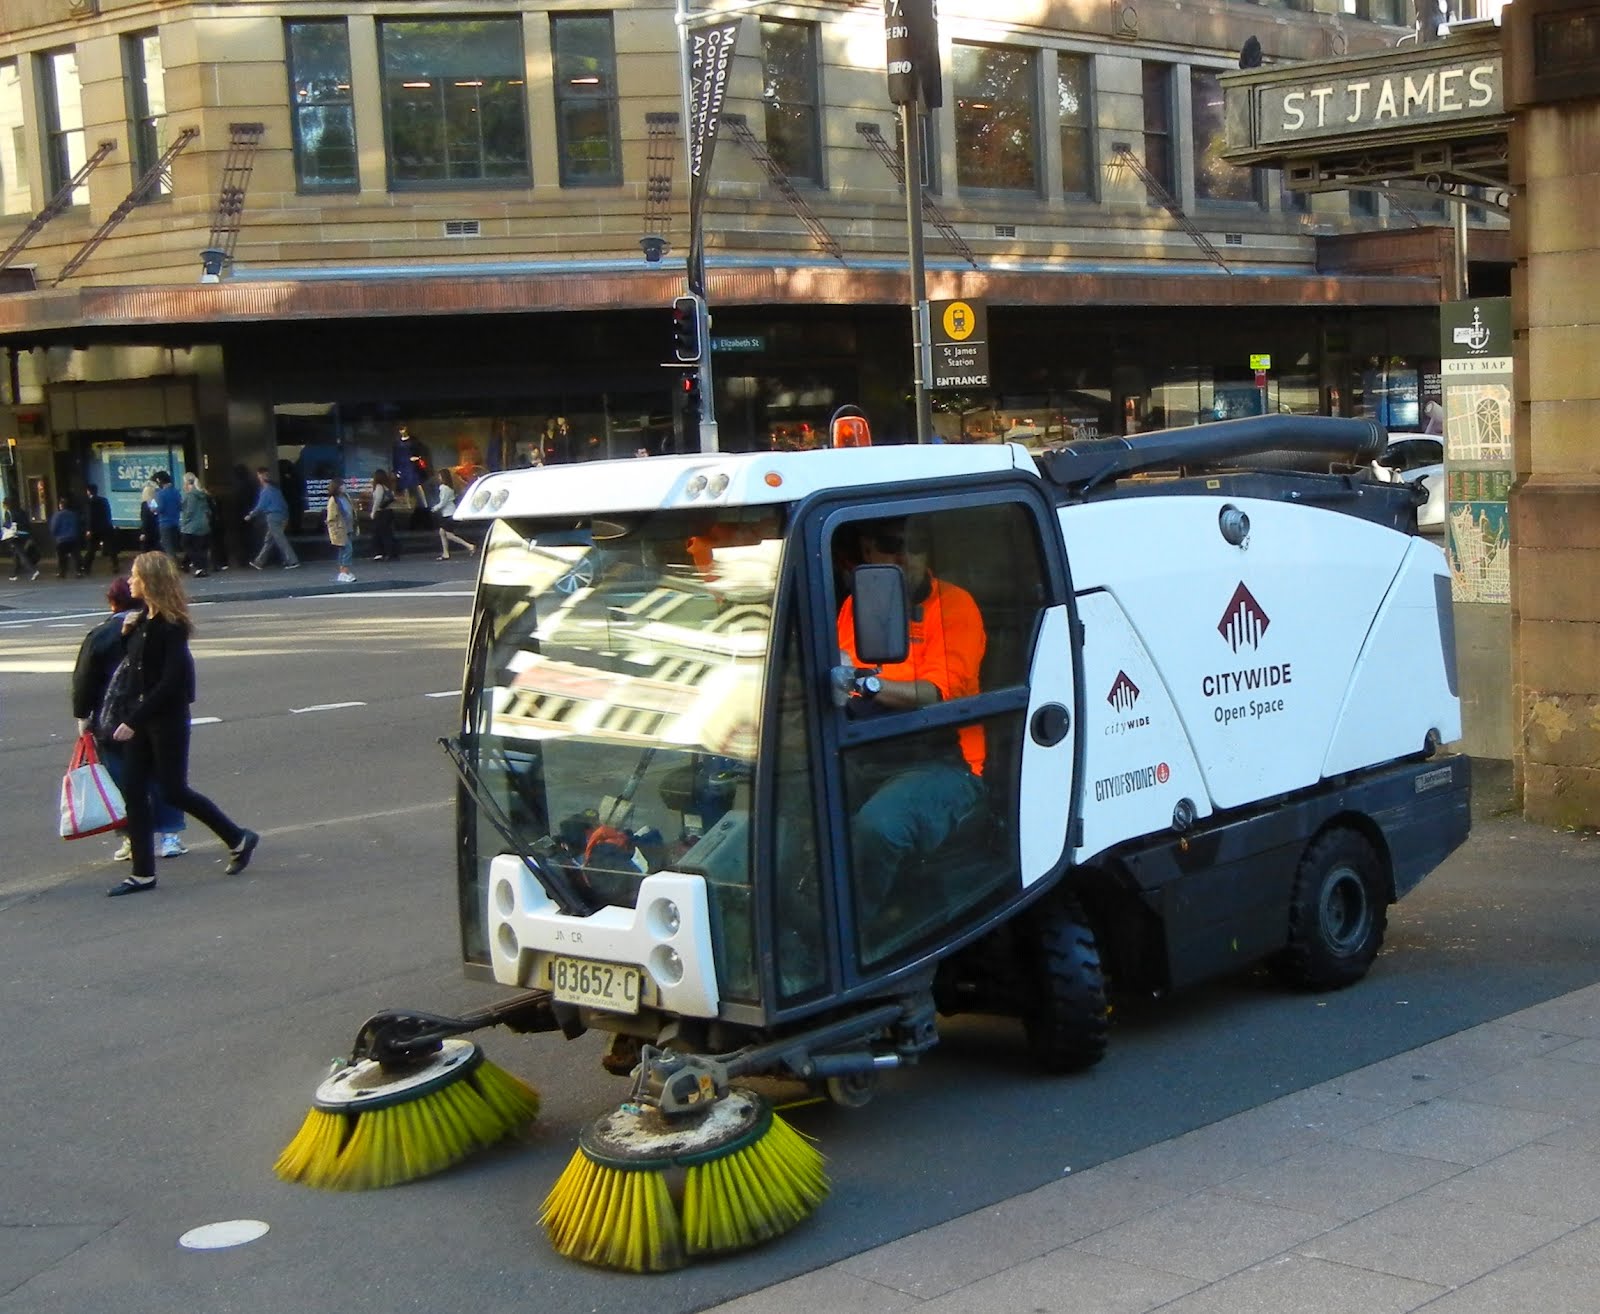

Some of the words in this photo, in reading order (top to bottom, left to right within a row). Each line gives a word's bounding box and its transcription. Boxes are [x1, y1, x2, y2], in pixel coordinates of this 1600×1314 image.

[692, 35, 706, 69] Art
[692, 30, 721, 177] Contemporary
[1283, 87, 1333, 131] ST
[1347, 66, 1494, 123] JAMES
[720, 338, 750, 348] Elizabeth
[751, 338, 760, 347] St
[943, 347, 951, 356] St
[954, 346, 977, 358] James
[947, 357, 975, 367] Station
[1448, 362, 1476, 372] CITY
[1481, 360, 1506, 370] MAP
[936, 374, 988, 387] ENTRANCE
[117, 465, 143, 480] SAVE
[129, 480, 140, 489] OR
[1203, 663, 1293, 697] CITYWIDE
[1214, 705, 1247, 726] Open
[1250, 699, 1285, 720] Space
[1104, 716, 1150, 736] cityWIDE
